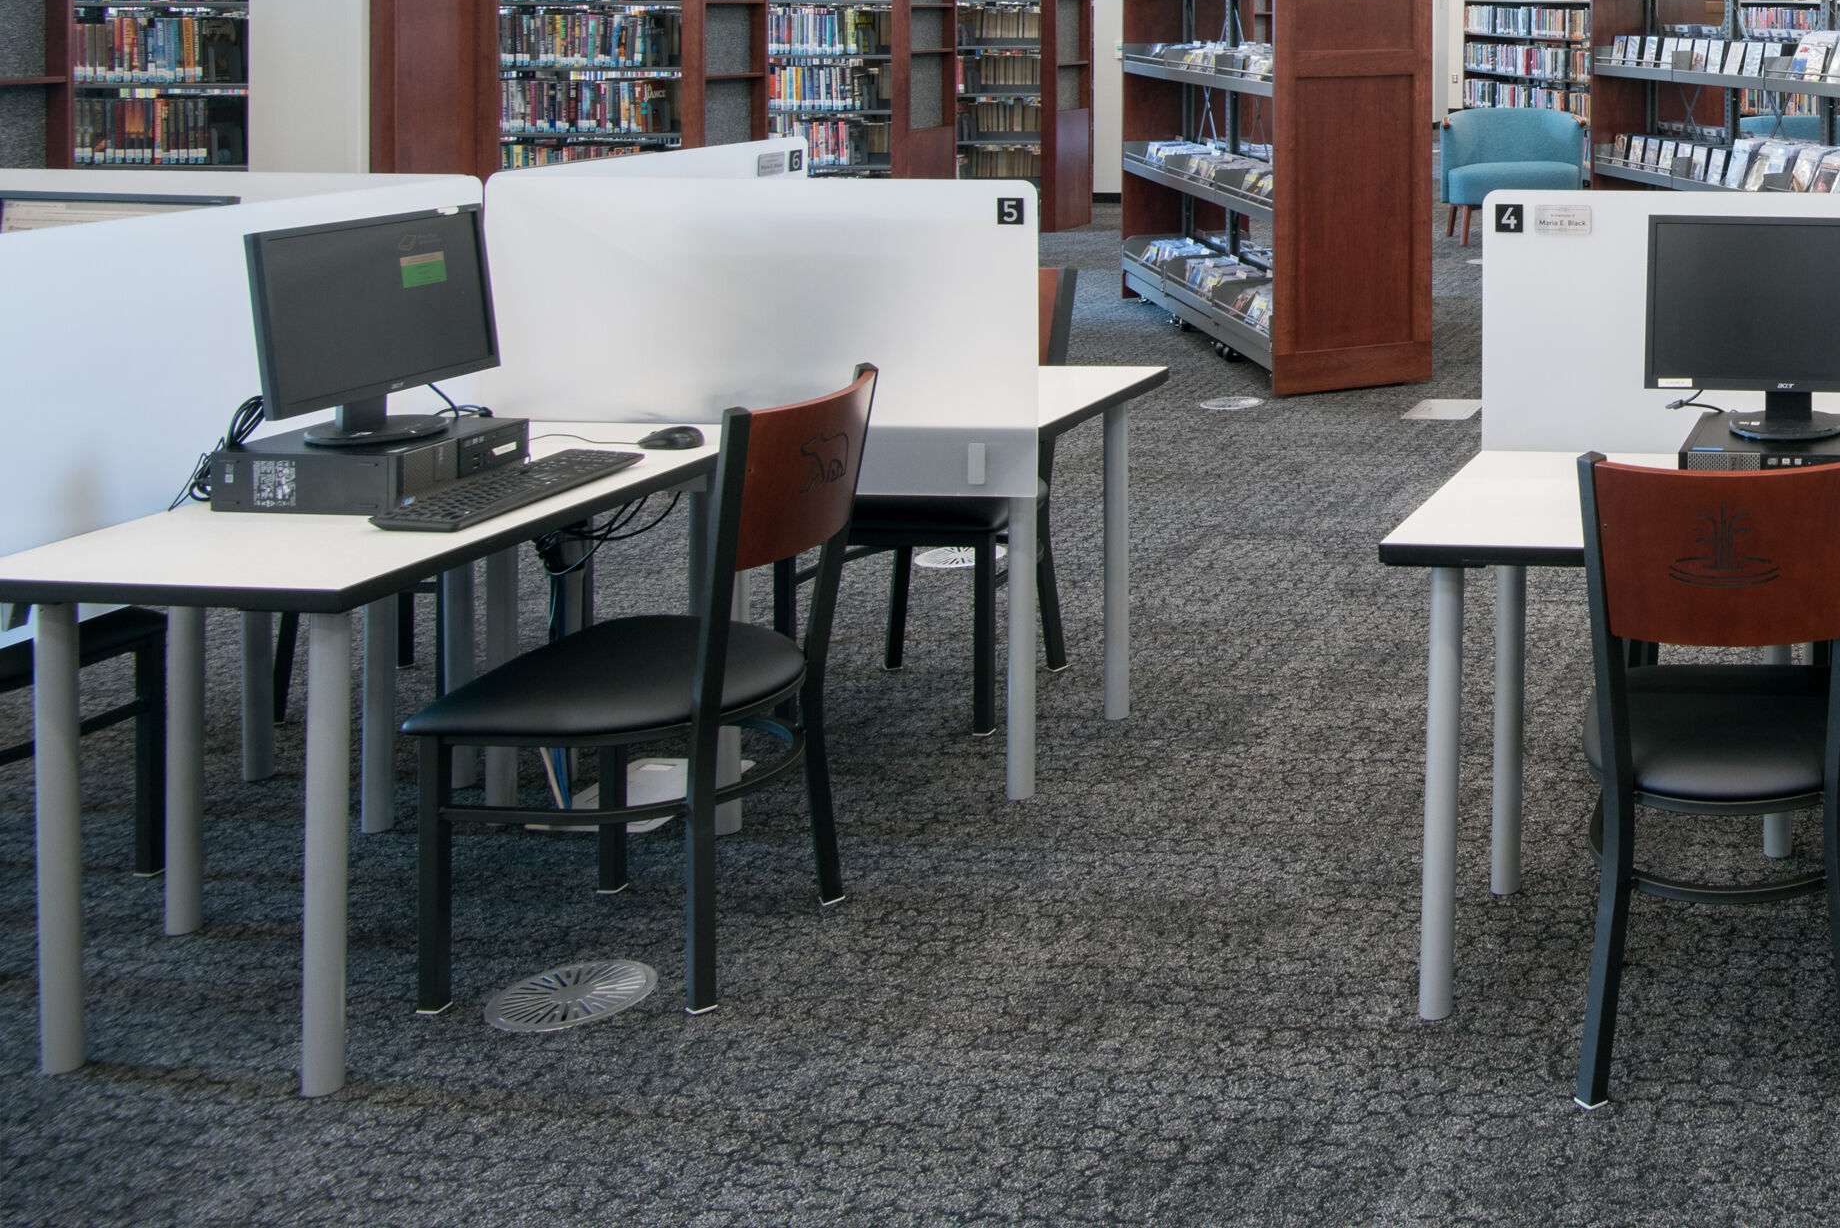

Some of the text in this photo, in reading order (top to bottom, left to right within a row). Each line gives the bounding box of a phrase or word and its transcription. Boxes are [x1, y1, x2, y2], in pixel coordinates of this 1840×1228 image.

[793, 152, 800, 169] 6
[1003, 201, 1017, 222] 5
[1501, 207, 1518, 230] 4
